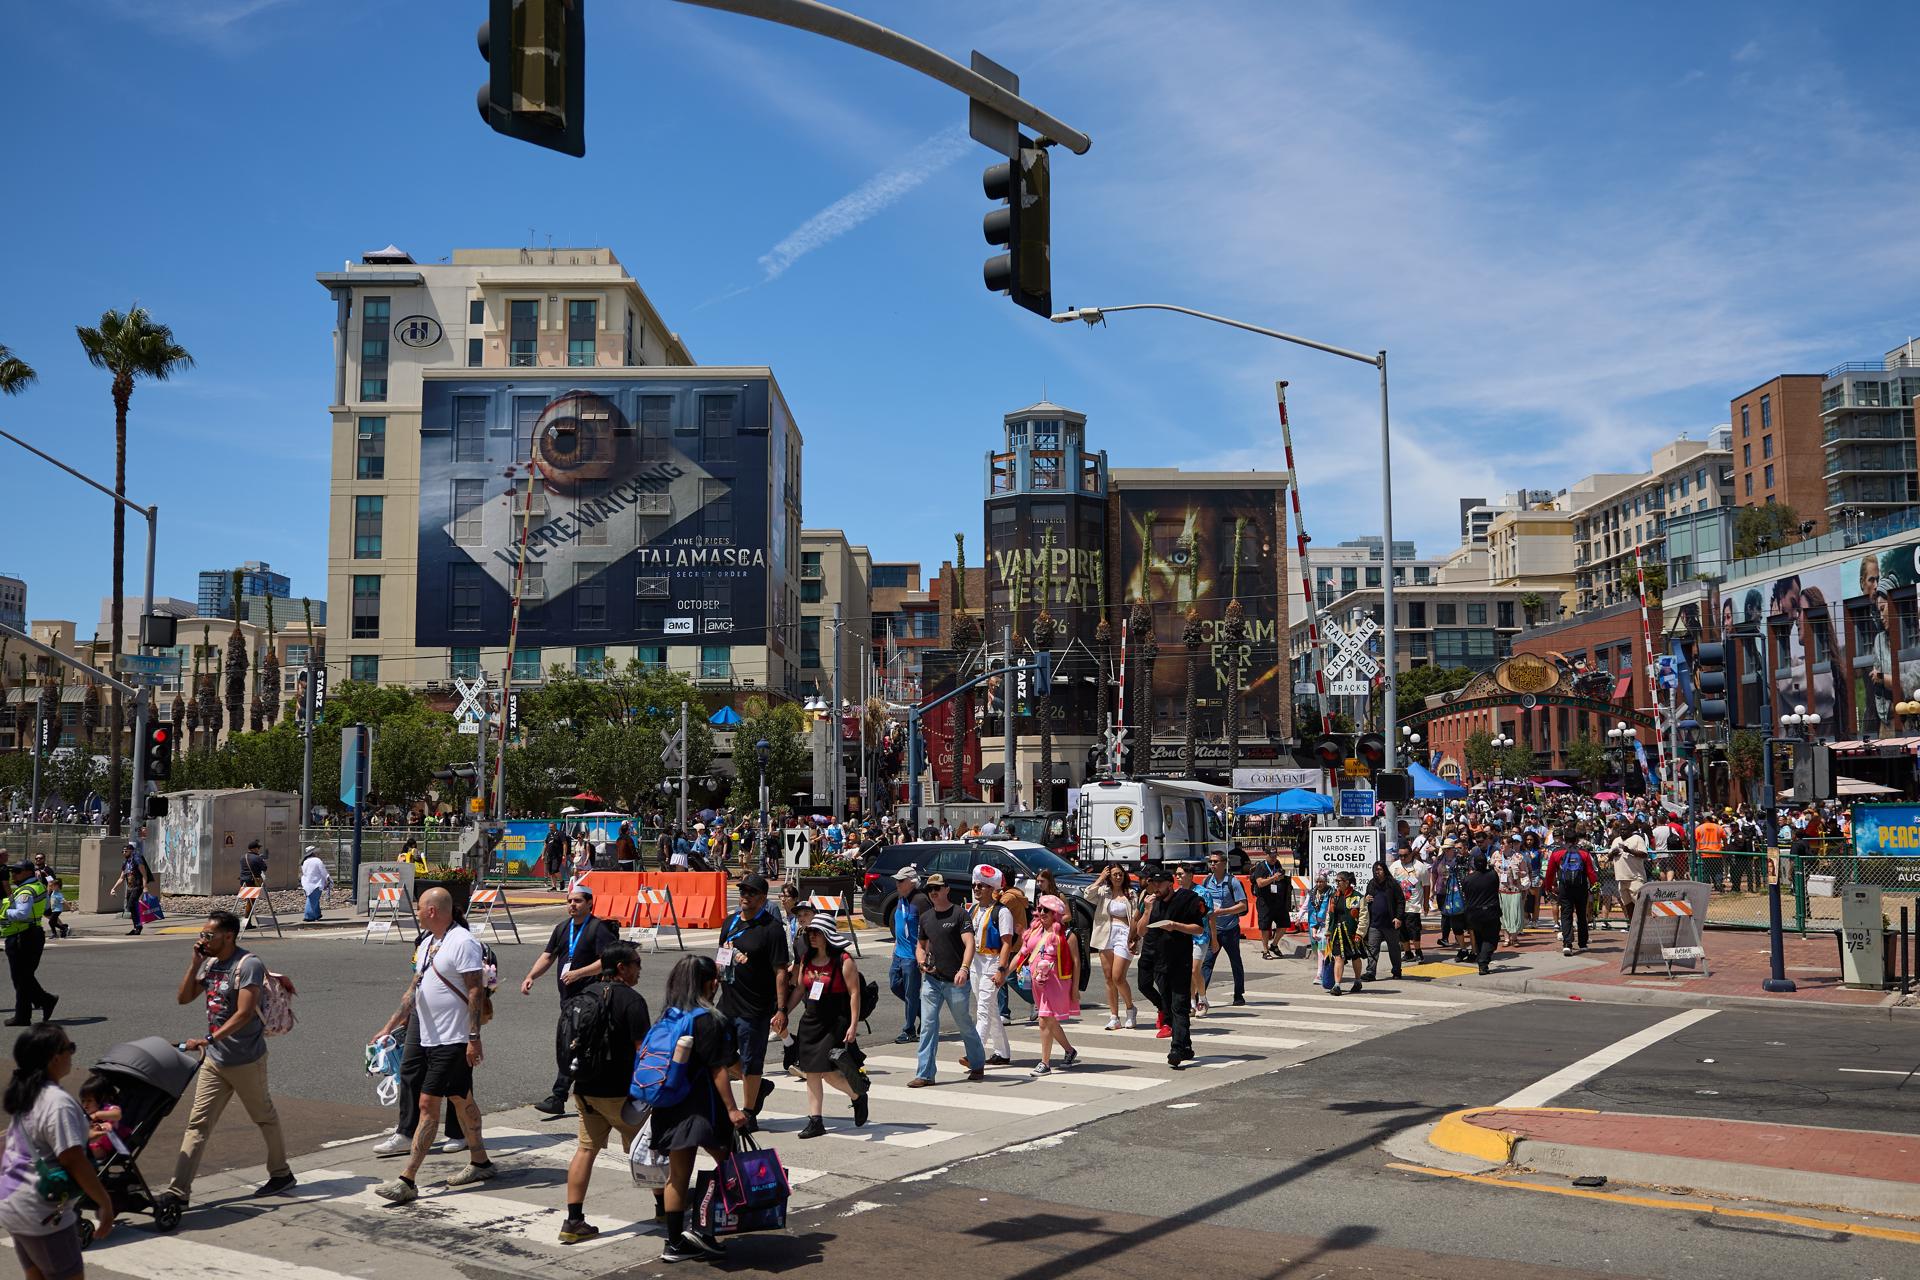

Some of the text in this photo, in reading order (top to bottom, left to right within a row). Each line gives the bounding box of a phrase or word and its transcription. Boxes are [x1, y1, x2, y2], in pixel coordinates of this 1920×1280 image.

[493, 462, 686, 569] WE'RE WATCHING
[704, 537, 730, 545] RICE'S
[637, 548, 765, 569] TALAMASCA
[677, 600, 720, 610] OCTOBER
[1326, 621, 1375, 677] CROSSING
[1346, 669, 1353, 679] 3
[316, 670, 325, 708] STARZ
[1332, 684, 1367, 692] TRACKS
[455, 678, 484, 718] CROSSING
[509, 694, 517, 728] STARZ
[1035, 705, 1066, 719] 226
[1318, 835, 1371, 843] N/B 5TH AVE
[1878, 825, 1920, 848] PEAC
[1323, 853, 1366, 862] CLOSED
[1898, 873, 1920, 882] AUG
